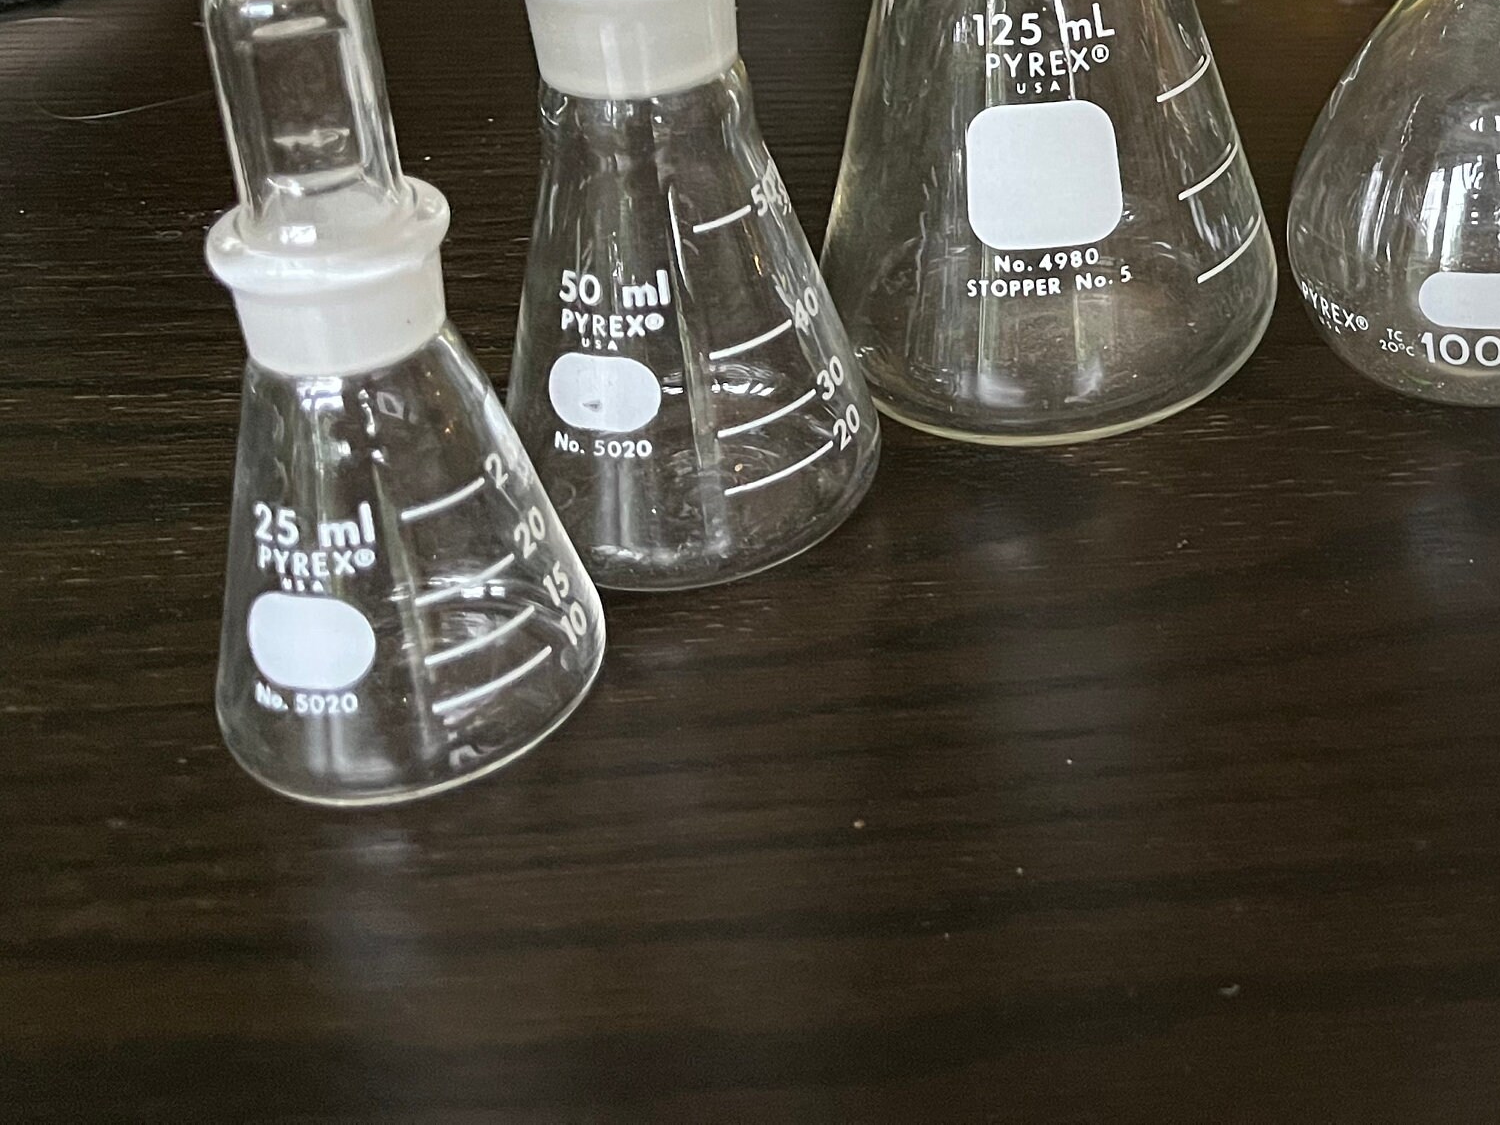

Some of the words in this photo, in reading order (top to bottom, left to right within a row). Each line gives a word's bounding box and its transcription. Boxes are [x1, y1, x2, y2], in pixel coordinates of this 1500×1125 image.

[972, 12, 1042, 47] 125
[1063, 2, 1116, 42] mL
[1016, 80, 1061, 95] USA
[994, 255, 1033, 273] No.
[1039, 247, 1099, 272] 4980
[559, 269, 602, 306] 50
[622, 269, 671, 308] ml
[966, 277, 1061, 297] STOPPER
[1075, 272, 1113, 291] No.
[1120, 265, 1133, 283] 5
[795, 286, 819, 335] 40
[581, 337, 619, 351] USA
[1386, 327, 1403, 343] TC
[817, 355, 844, 401] 30
[554, 430, 585, 454] No.
[593, 439, 653, 458] 5020
[833, 403, 860, 451] 20
[254, 502, 300, 546] 25
[318, 501, 376, 548] ml
[514, 506, 546, 559] 20
[543, 561, 570, 607] 15
[561, 601, 587, 645] 10
[294, 691, 359, 714] 5020
